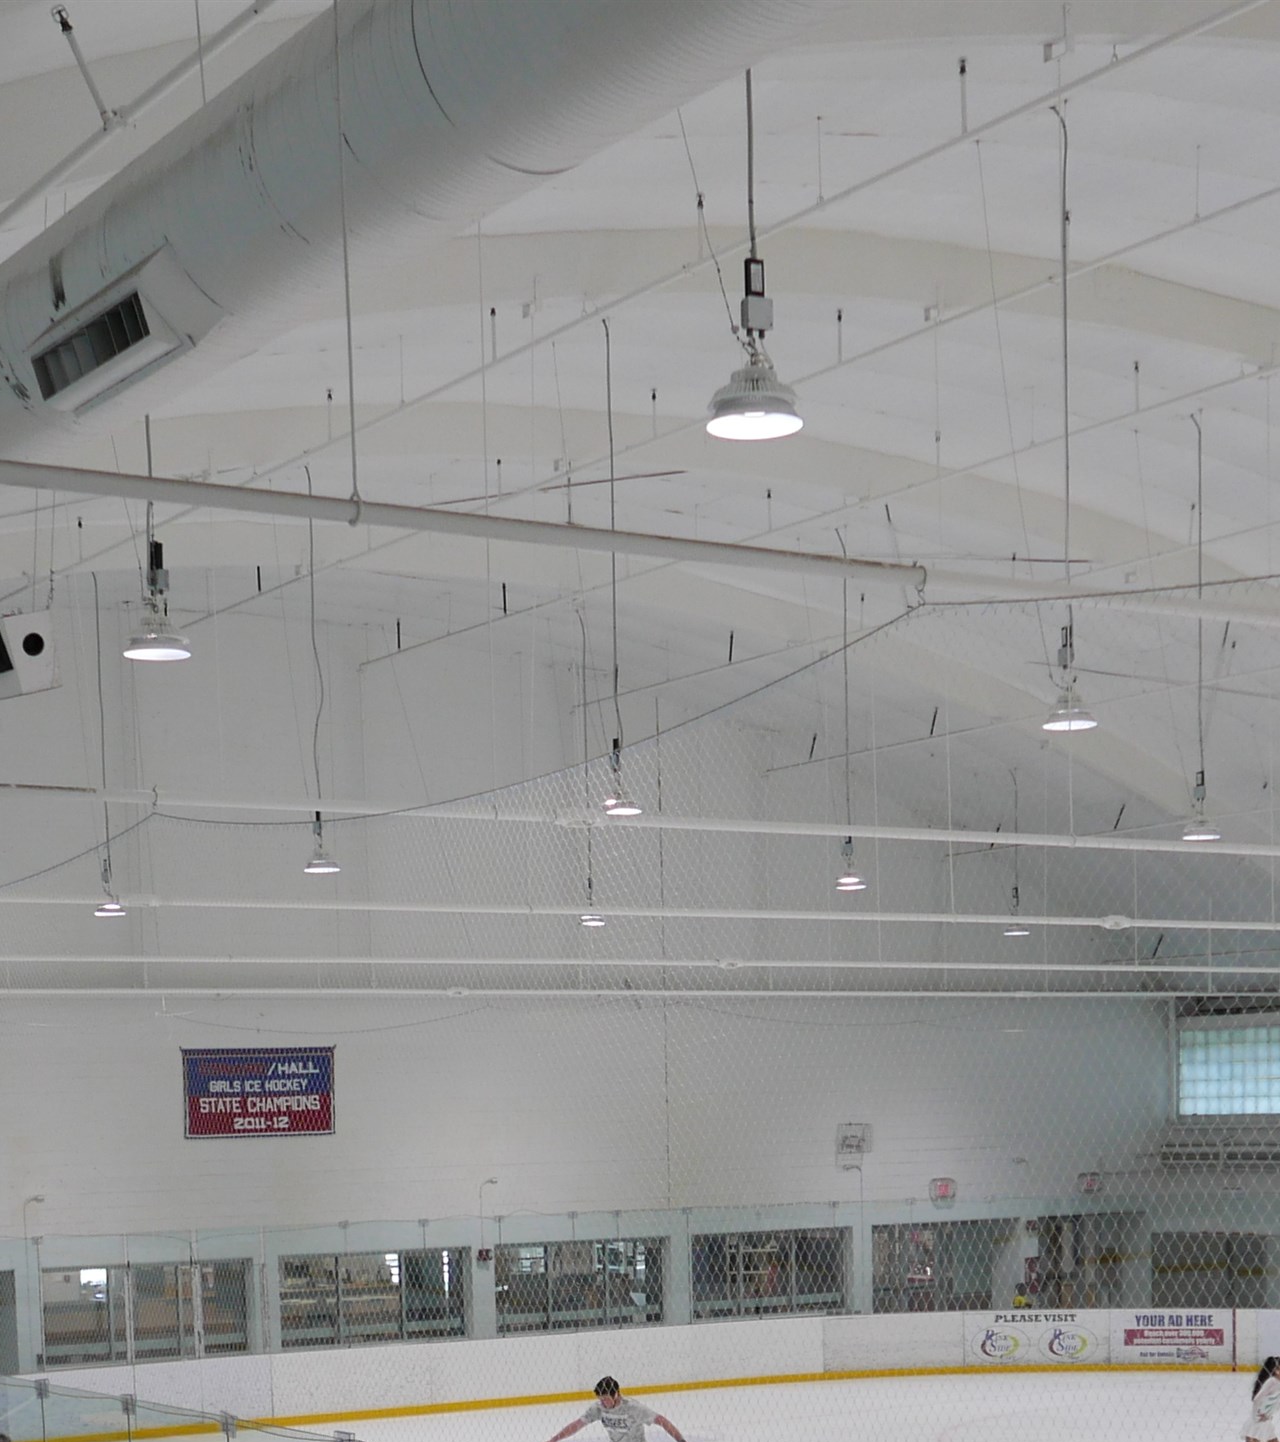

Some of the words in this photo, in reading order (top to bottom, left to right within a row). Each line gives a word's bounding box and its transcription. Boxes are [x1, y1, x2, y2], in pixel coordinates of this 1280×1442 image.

[209, 1080, 241, 1092] GIRLS
[244, 1080, 262, 1092] ICE
[265, 1079, 308, 1092] HOCKEY
[199, 1097, 242, 1113] STATE
[246, 1095, 321, 1112] CHAMPIONS
[233, 1116, 290, 1130] 2011-12
[994, 1314, 1042, 1323] PLEASE
[1043, 1313, 1077, 1323] VISIT
[1135, 1314, 1166, 1327] YOUR
[1167, 1314, 1183, 1327] AD
[1185, 1314, 1214, 1327] HERE
